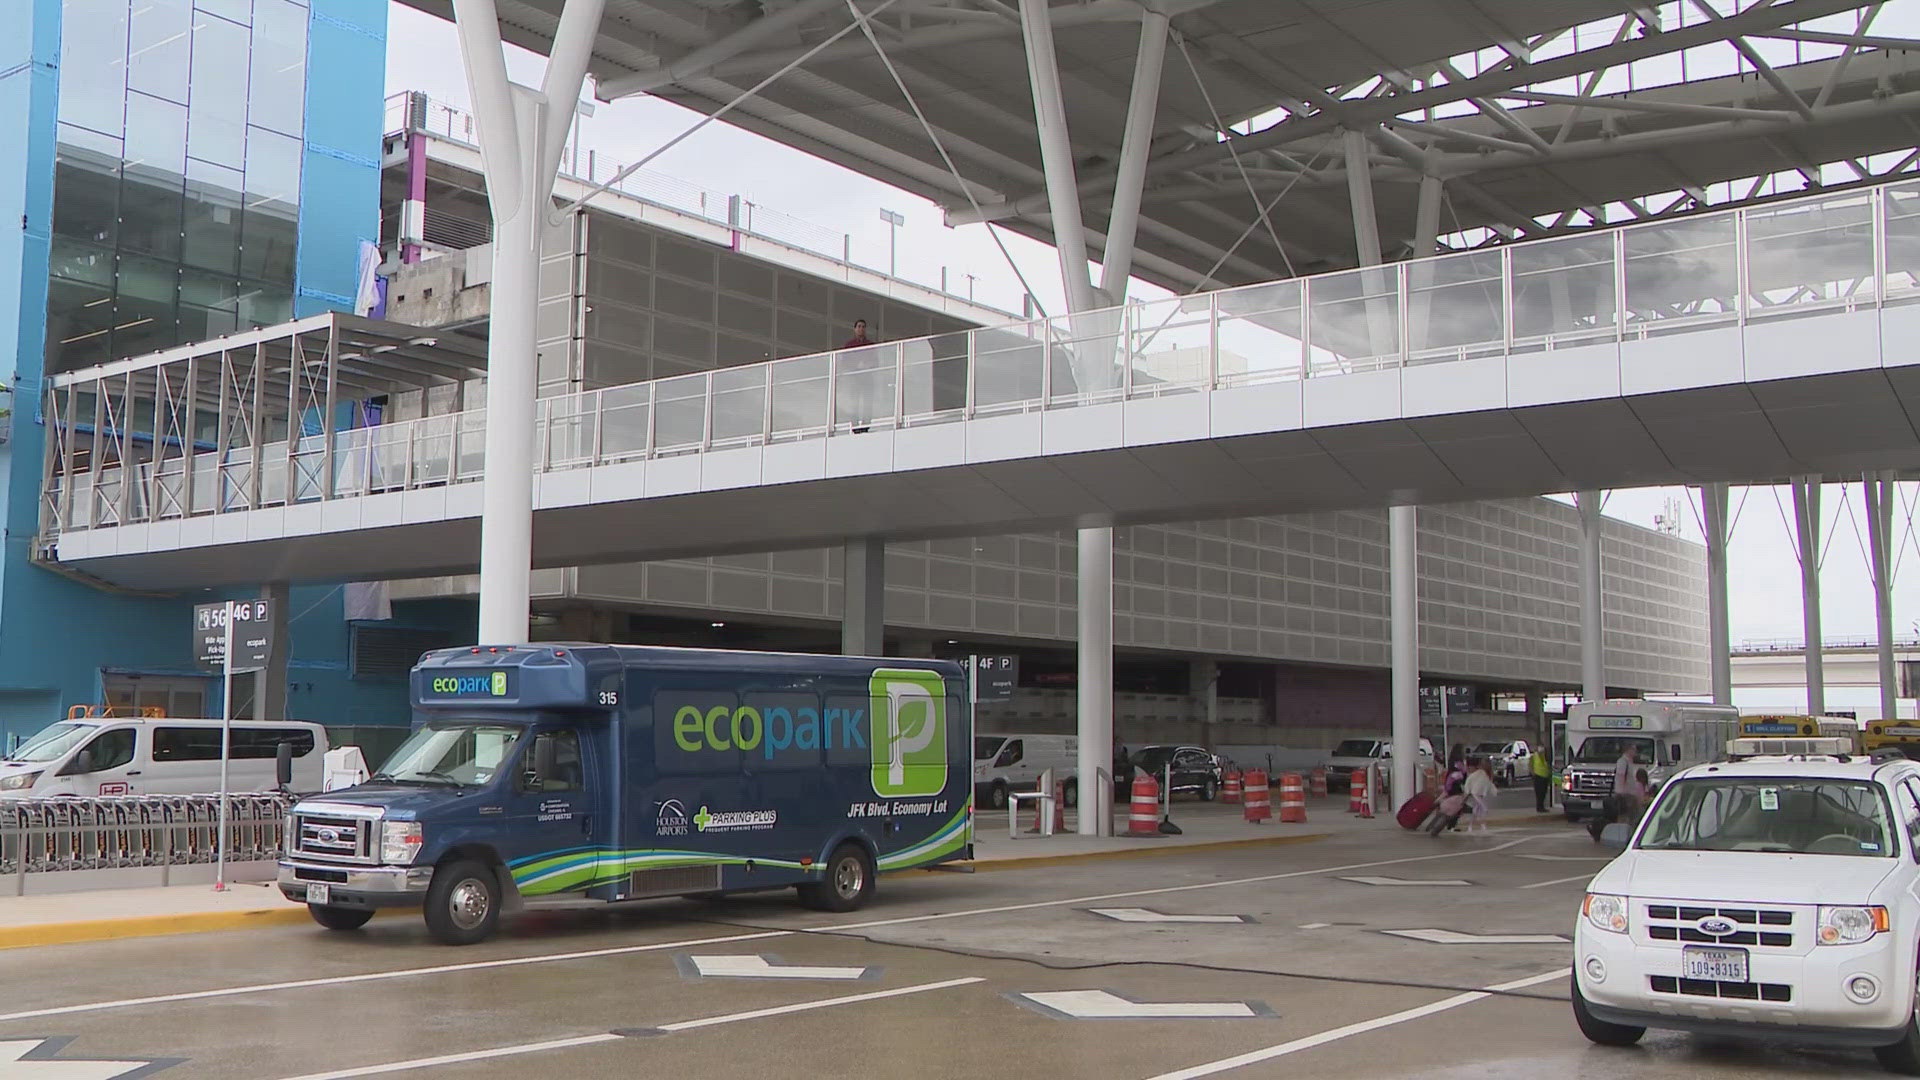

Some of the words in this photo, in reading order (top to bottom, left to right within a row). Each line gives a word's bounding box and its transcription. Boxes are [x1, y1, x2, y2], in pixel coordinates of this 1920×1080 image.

[211, 609, 226, 627] 5G
[234, 604, 250, 620] 4G
[980, 658, 993, 669] 4F
[433, 675, 490, 695] ecopark
[599, 691, 618, 705] 315
[673, 704, 866, 761] ecopark
[847, 803, 867, 818] JFK
[867, 801, 891, 817] Blvd.
[892, 801, 933, 816] Economy
[933, 800, 948, 813] Lot
[656, 816, 688, 826] HOUSTON
[712, 812, 752, 824] PARKING
[753, 810, 776, 822] PLUS
[656, 825, 688, 836] AIRPORTS
[1702, 951, 1727, 960] TEXAS
